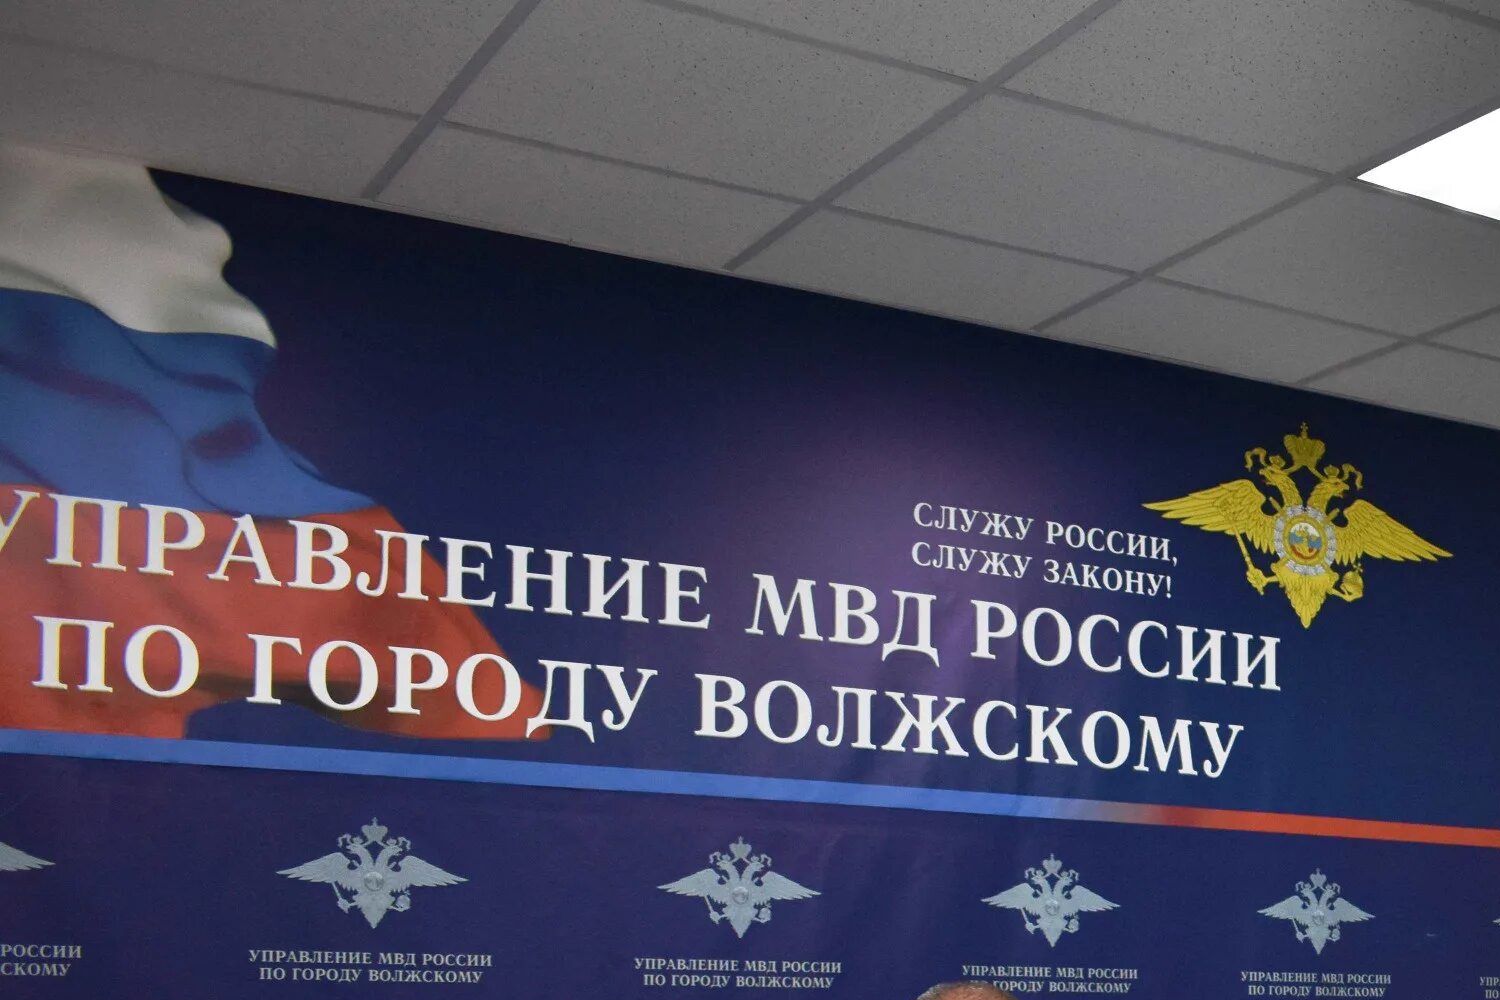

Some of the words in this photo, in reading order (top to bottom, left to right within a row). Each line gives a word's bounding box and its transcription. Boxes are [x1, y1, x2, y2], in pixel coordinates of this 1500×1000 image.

[912, 502, 1034, 541] СЛУЖУ
[1045, 520, 1178, 566] РОССИИ,
[911, 541, 1029, 579] СЛУЖУ
[1043, 559, 1172, 599] ЗАКОНУ!
[0, 490, 710, 629] УПРАВЛЕНИЕ
[745, 573, 941, 666] МВД
[970, 599, 1282, 691] РОССИИ
[32, 615, 200, 698] ПО
[246, 634, 658, 743] ГОРОДУ
[694, 673, 1244, 778] ВОЛЖСКОМУ
[0, 944, 82, 958] РОССИИ
[248, 949, 372, 966] УПРАВЛЕНИЕ
[378, 952, 416, 968] МВД
[422, 952, 493, 967] РОССИИ
[0, 962, 71, 976] СКОМУ
[634, 957, 740, 972] УПРАВЛЕНИЕ
[744, 959, 777, 973] МВД
[781, 960, 842, 974] РОССИИ
[962, 965, 1051, 977] УПРАВЛЕНИЕ
[1055, 968, 1084, 979] МВД
[1087, 968, 1138, 979] РОССИИ
[259, 967, 287, 981] ПО
[293, 967, 363, 983] ГОРОДУ
[368, 969, 483, 983] ВОЛЖСКОМУ
[643, 973, 667, 986] ПО
[672, 973, 731, 988] ГОРОДУ
[735, 974, 834, 989] ВОЛЖСКОМУ
[1241, 972, 1317, 982] УПРАВЛЕНИЕ
[1321, 974, 1344, 984] МВД
[1347, 974, 1391, 984] РОССИИ
[993, 980, 1044, 993] ГОРОДУ
[1049, 981, 1131, 993] ВОЛЖСКОМУ
[1248, 985, 1265, 995] ПО
[1269, 985, 1311, 997] ГОРОДУ
[1315, 986, 1386, 997] ВОЛЖСКОМУ
[1485, 989, 1499, 999] ПО
